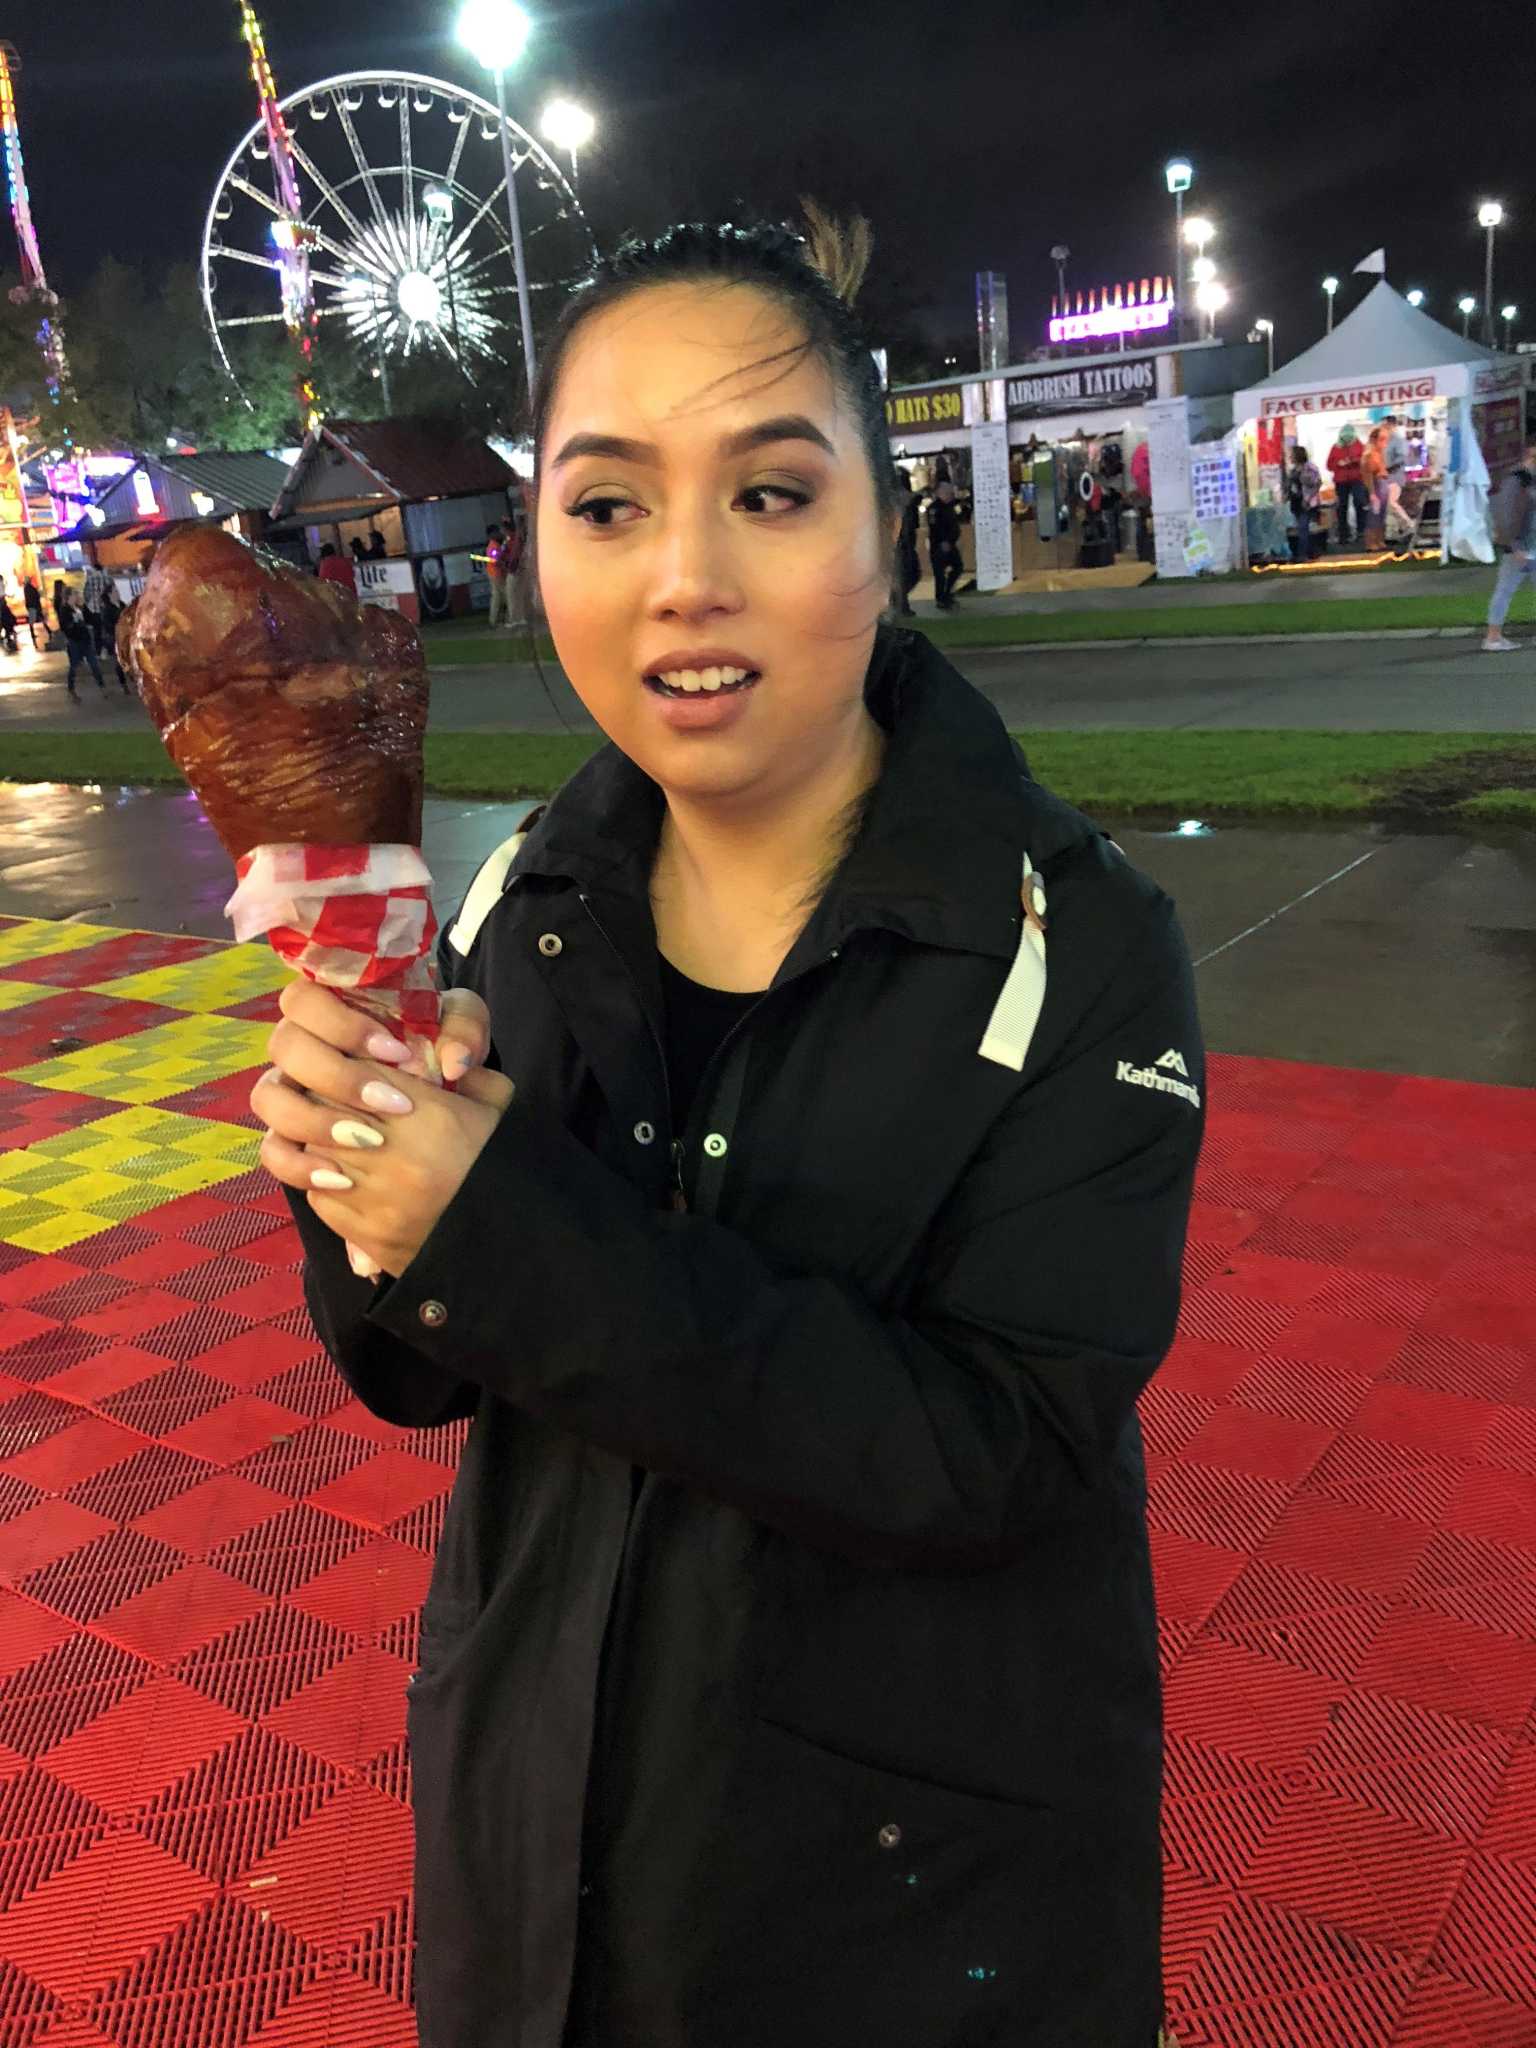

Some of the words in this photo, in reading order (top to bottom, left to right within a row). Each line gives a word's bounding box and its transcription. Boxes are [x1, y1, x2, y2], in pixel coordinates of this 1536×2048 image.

[1008, 373, 1080, 405] AIRBRUSH
[1083, 362, 1153, 395] TATTOOS
[1265, 397, 1314, 415] FACE
[1320, 382, 1431, 410] PAINTING
[895, 395, 930, 424] HATS
[932, 392, 960, 420] $30
[360, 565, 387, 589] Lite
